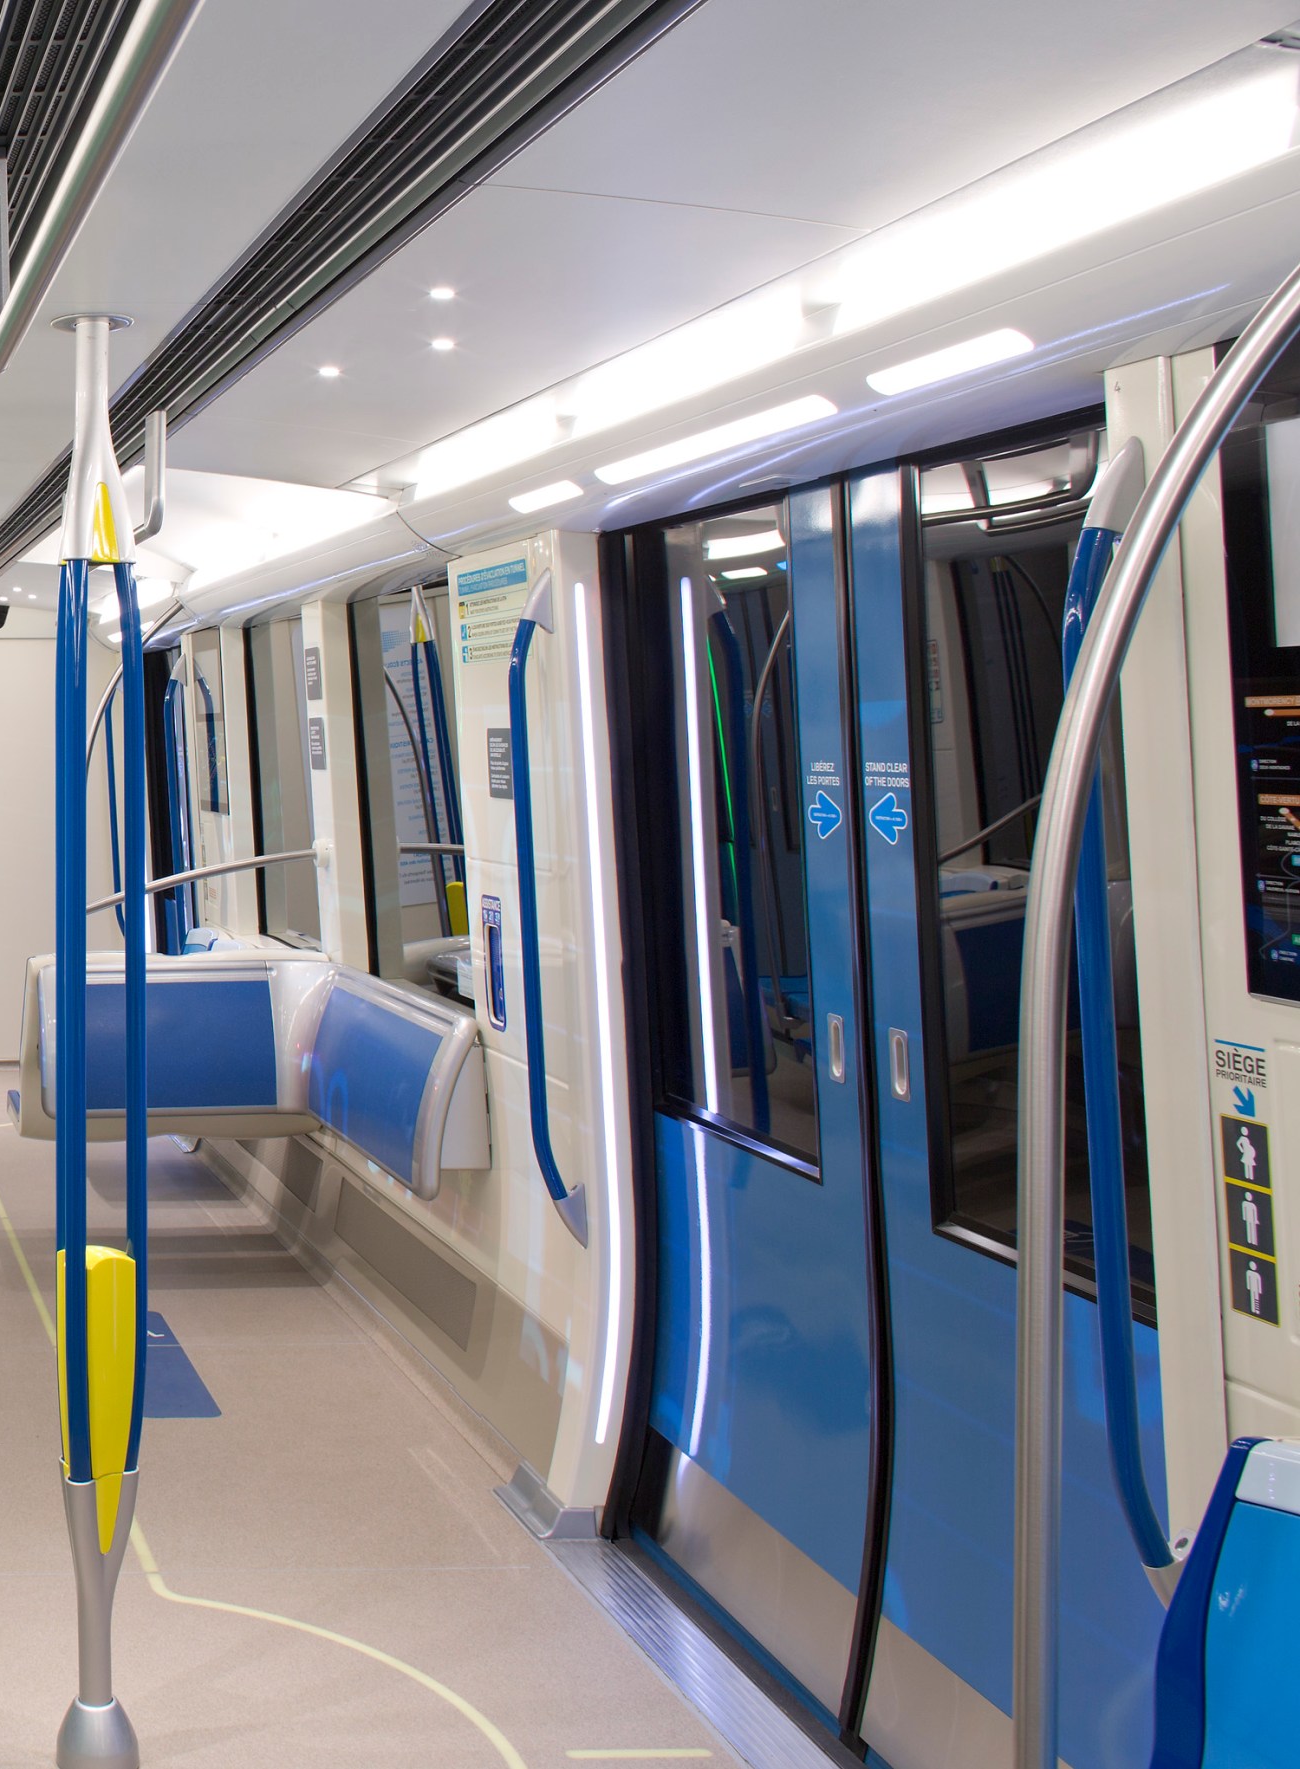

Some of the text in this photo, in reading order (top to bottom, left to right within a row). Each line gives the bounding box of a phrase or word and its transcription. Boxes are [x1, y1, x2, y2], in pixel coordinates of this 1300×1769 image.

[810, 760, 834, 772] LIBÉREZ
[865, 762, 908, 773] STAND CLEAR
[807, 776, 840, 786] LES PORTES
[864, 776, 910, 788] OF THE DOORS
[1216, 1048, 1266, 1077] SIÈGE
[1216, 1068, 1267, 1088] PRIORITAIRE
